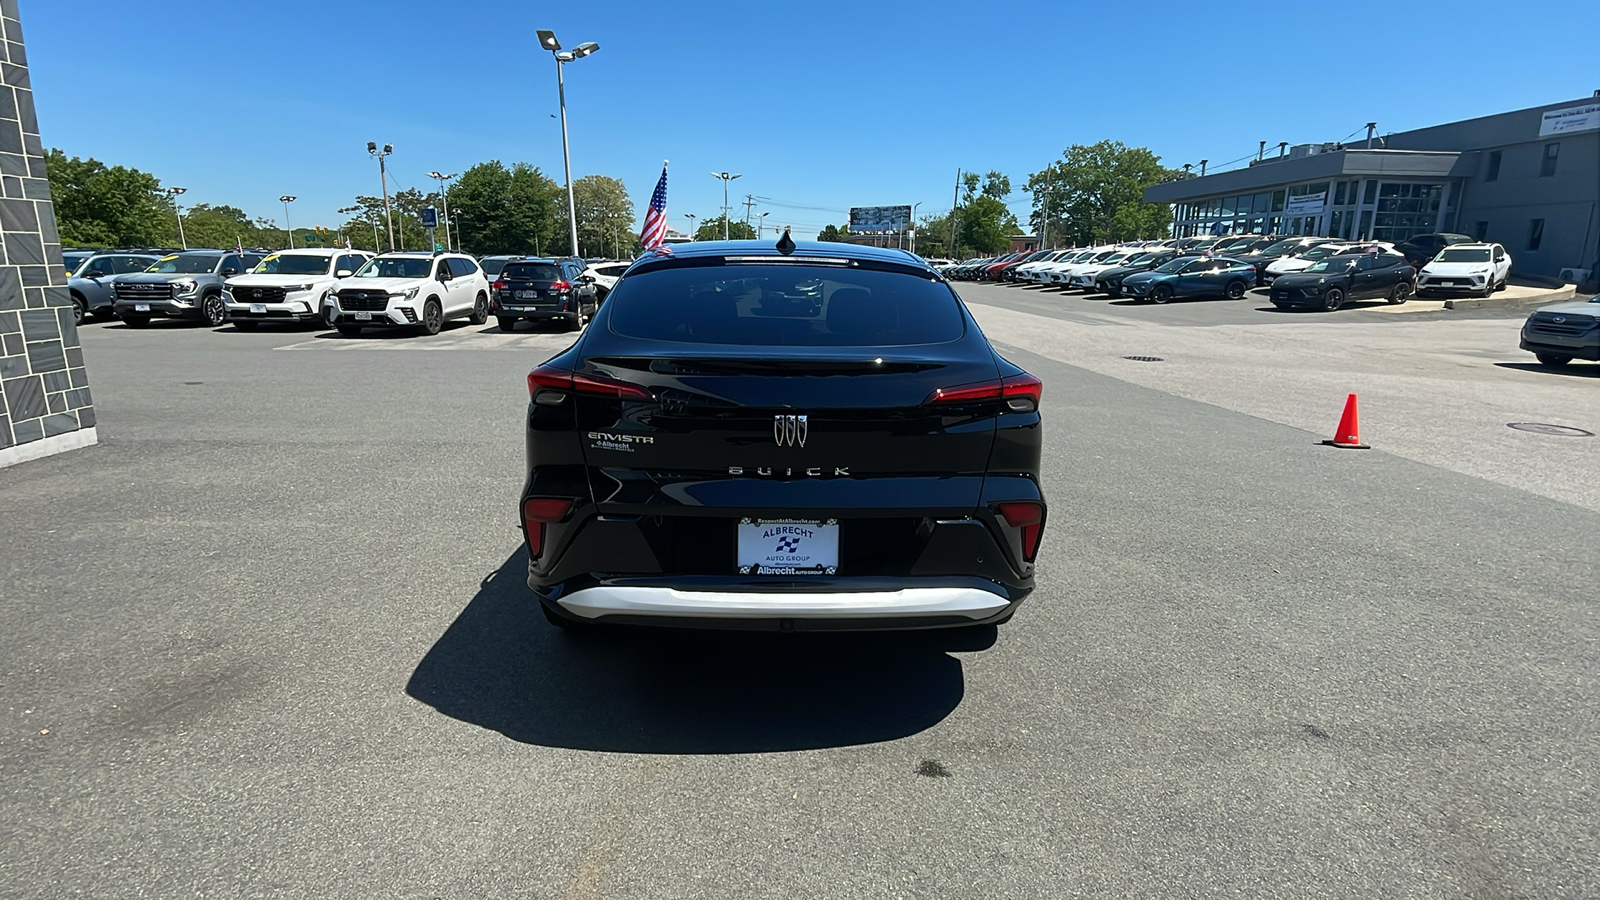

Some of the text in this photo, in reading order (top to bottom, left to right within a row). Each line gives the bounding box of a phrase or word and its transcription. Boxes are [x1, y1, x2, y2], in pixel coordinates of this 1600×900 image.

[588, 431, 654, 444] ENVISTA
[602, 441, 629, 449] Albrecht
[728, 466, 850, 476] BUICK
[762, 526, 814, 539] ALBRECHT
[757, 567, 796, 575] Albrecht
